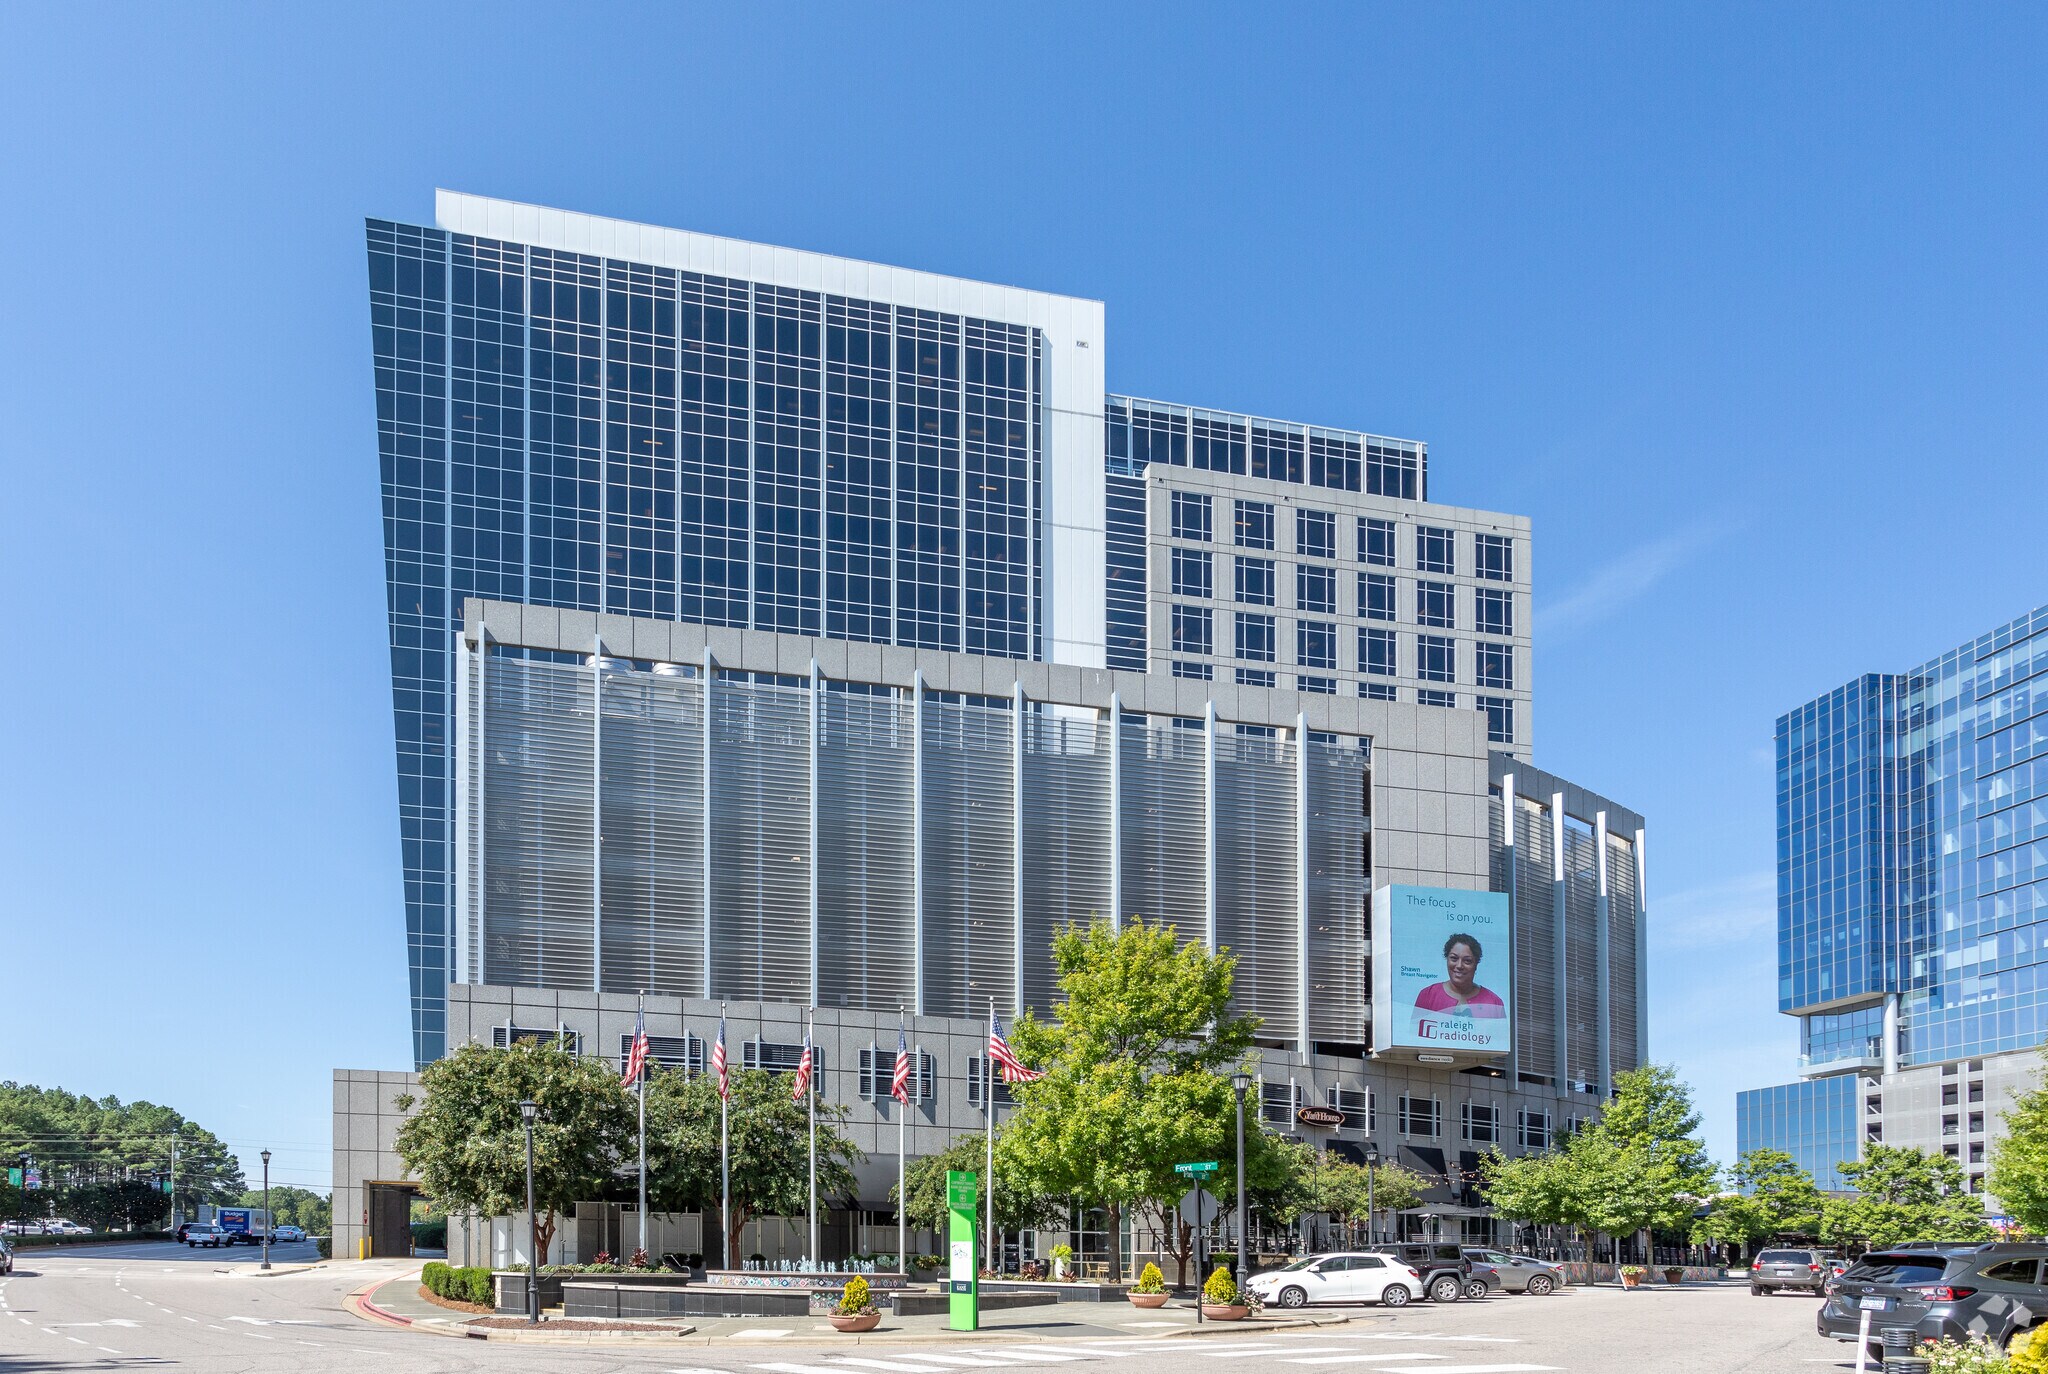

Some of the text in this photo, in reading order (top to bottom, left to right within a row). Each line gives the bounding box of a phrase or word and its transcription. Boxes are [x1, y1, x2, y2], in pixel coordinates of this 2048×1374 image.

[1406, 895, 1456, 908] The focus
[1446, 911, 1493, 925] is on you.
[1440, 1020, 1474, 1032] raleigh
[1440, 1031, 1492, 1045] radiology
[1305, 1110, 1340, 1122] Yard House
